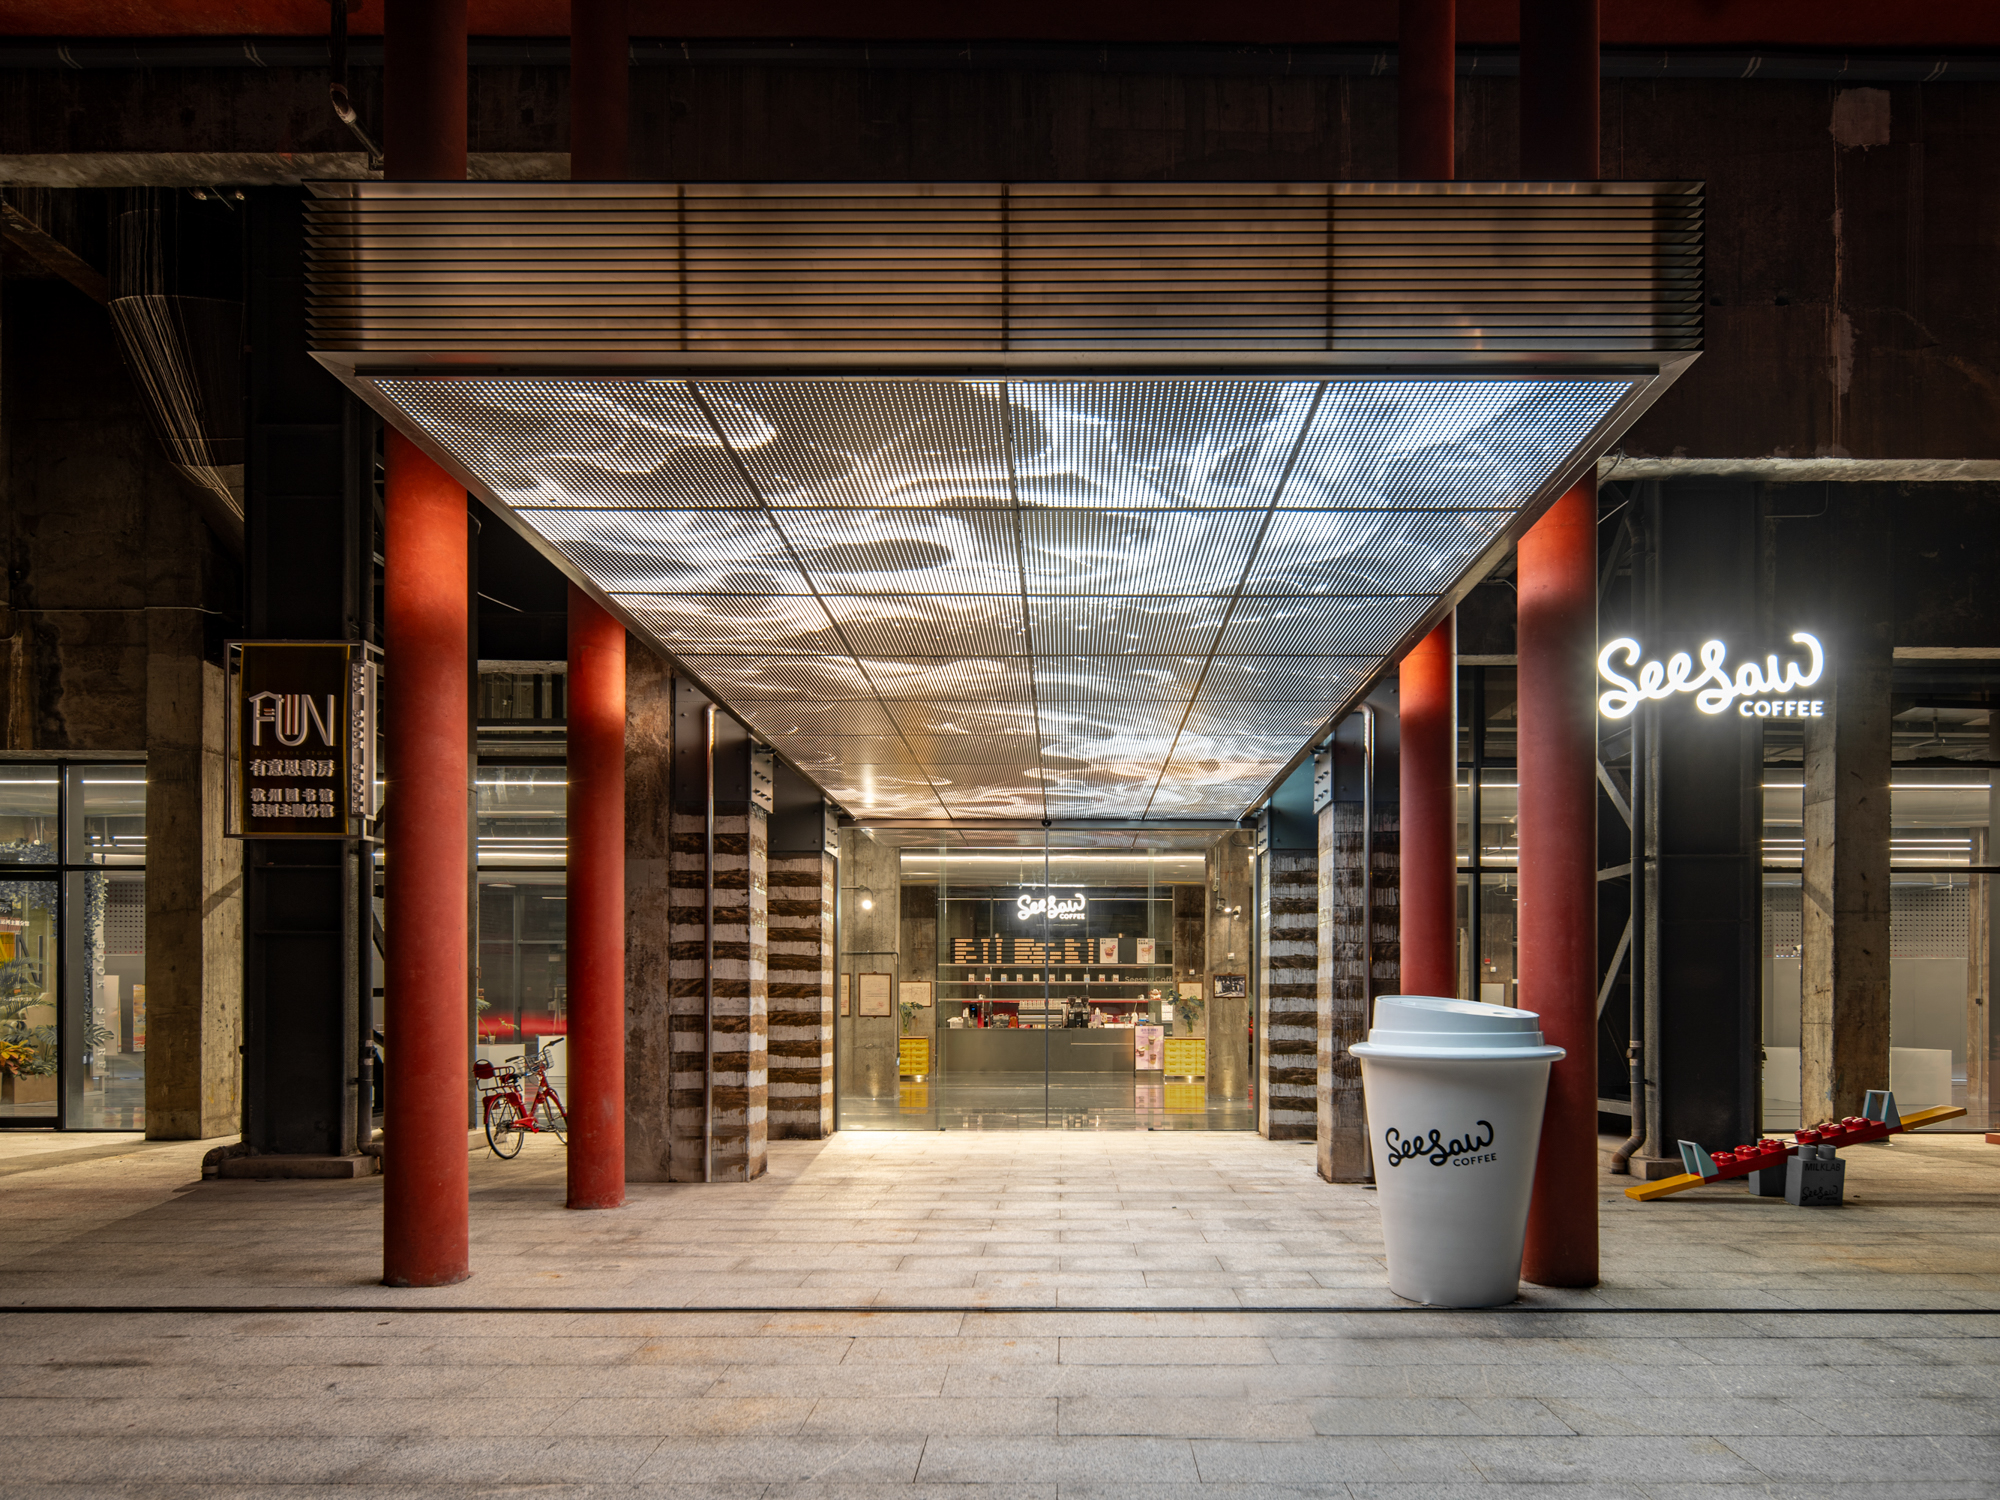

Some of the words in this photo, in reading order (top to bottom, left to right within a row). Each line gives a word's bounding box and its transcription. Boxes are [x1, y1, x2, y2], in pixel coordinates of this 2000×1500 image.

[352, 665, 365, 696] FUN
[248, 690, 335, 747] FUN
[1739, 700, 1824, 717] COFFEE
[352, 709, 365, 749] BOOK
[249, 758, 335, 777] 有意思書房
[352, 762, 365, 814] STORE
[96, 940, 106, 989] BOOK
[96, 1007, 106, 1069] STRE
[1453, 1153, 1497, 1167] COFFEE
[1804, 1162, 1841, 1171] MILKLAB
